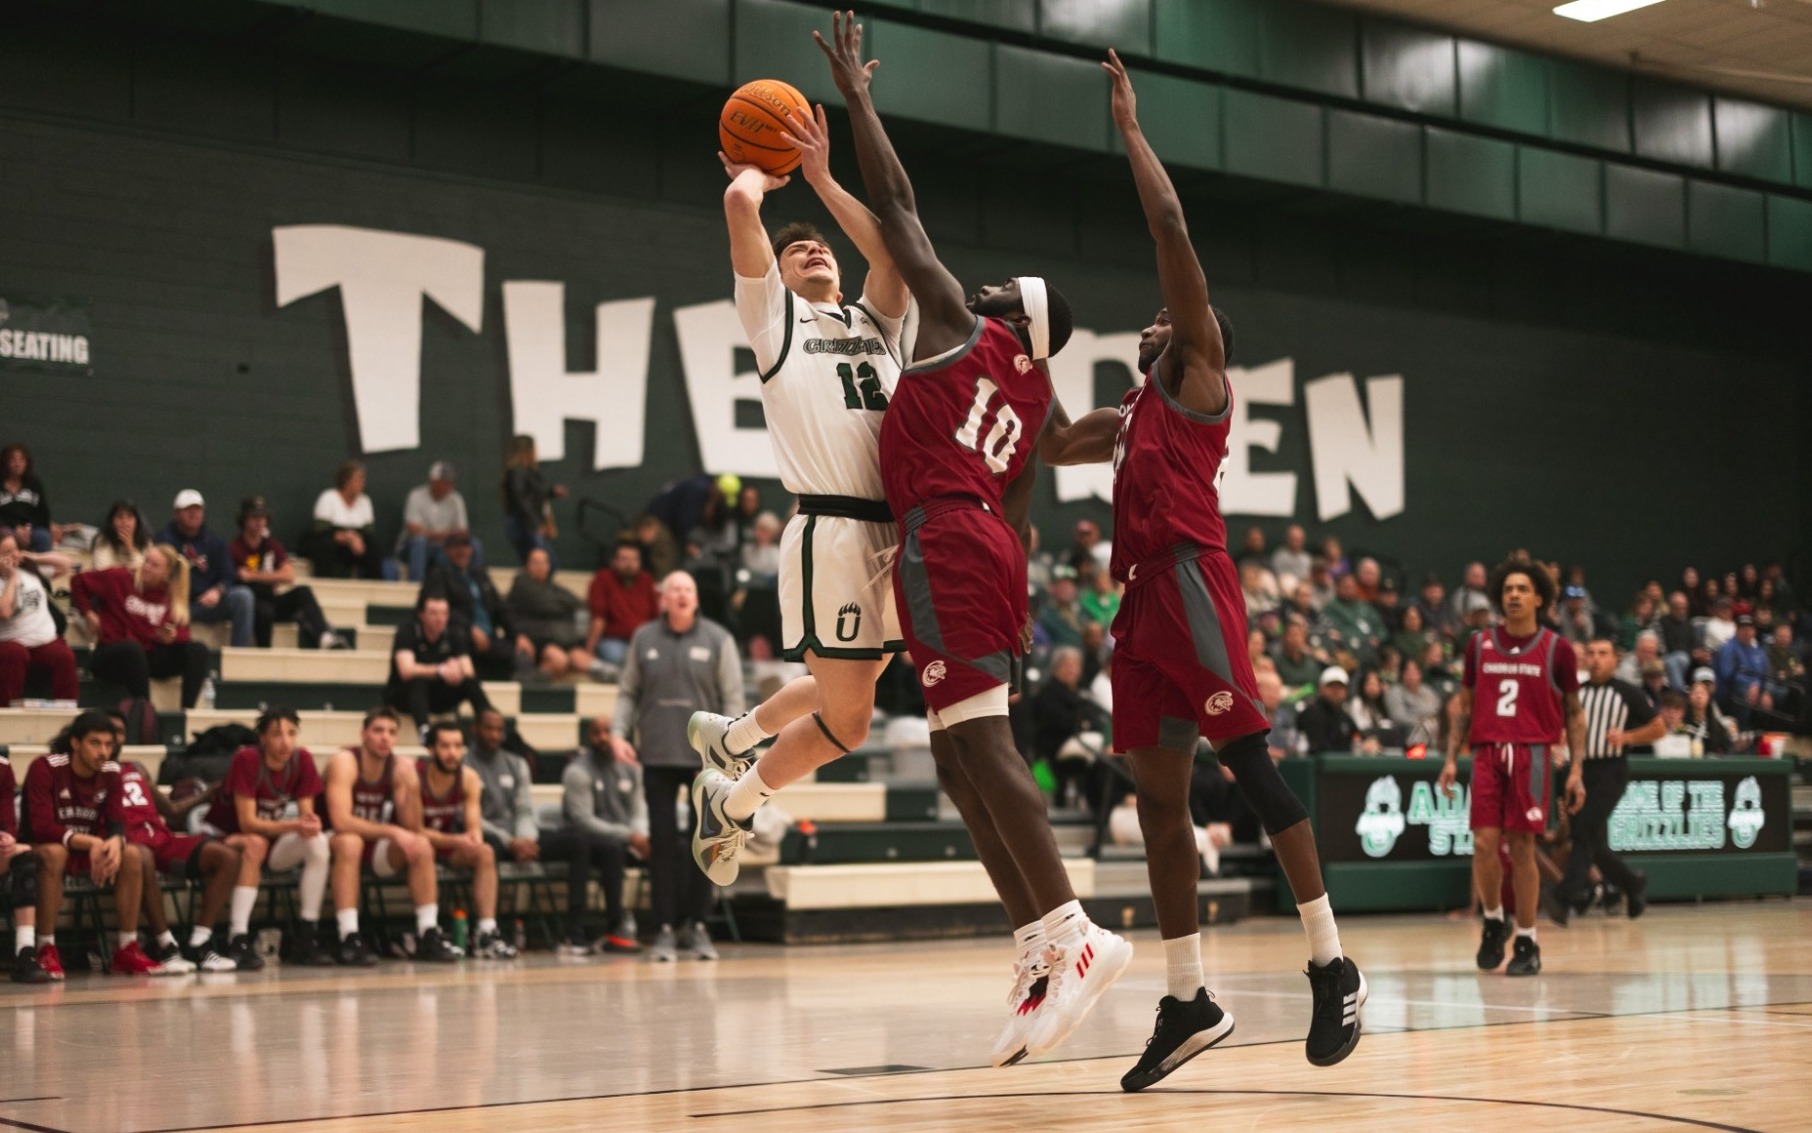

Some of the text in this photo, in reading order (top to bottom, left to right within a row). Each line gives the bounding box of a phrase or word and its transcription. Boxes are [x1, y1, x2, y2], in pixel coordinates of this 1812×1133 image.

[0, 328, 89, 365] SEATING
[273, 223, 1405, 523] THE DEN
[836, 361, 889, 411] 12
[955, 376, 1023, 474] 10
[1496, 678, 1520, 717] 2
